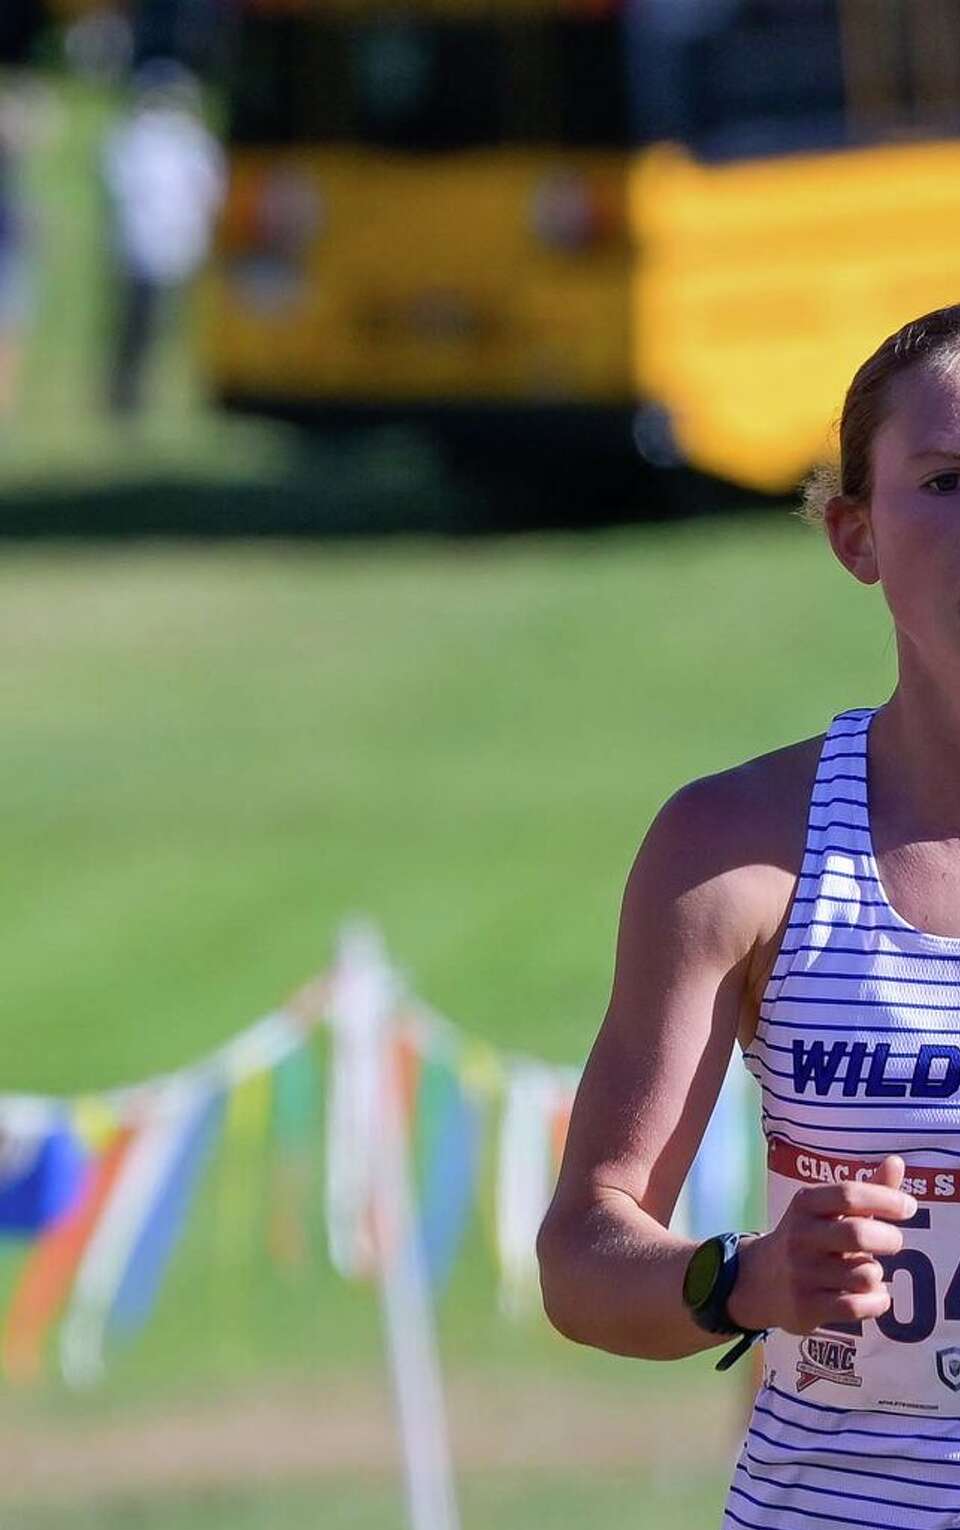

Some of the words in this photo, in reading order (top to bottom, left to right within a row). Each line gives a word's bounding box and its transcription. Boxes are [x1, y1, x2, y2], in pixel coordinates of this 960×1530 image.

[796, 1154, 850, 1183] CIAC
[855, 1166, 927, 1196] Css
[935, 1174, 955, 1197] S
